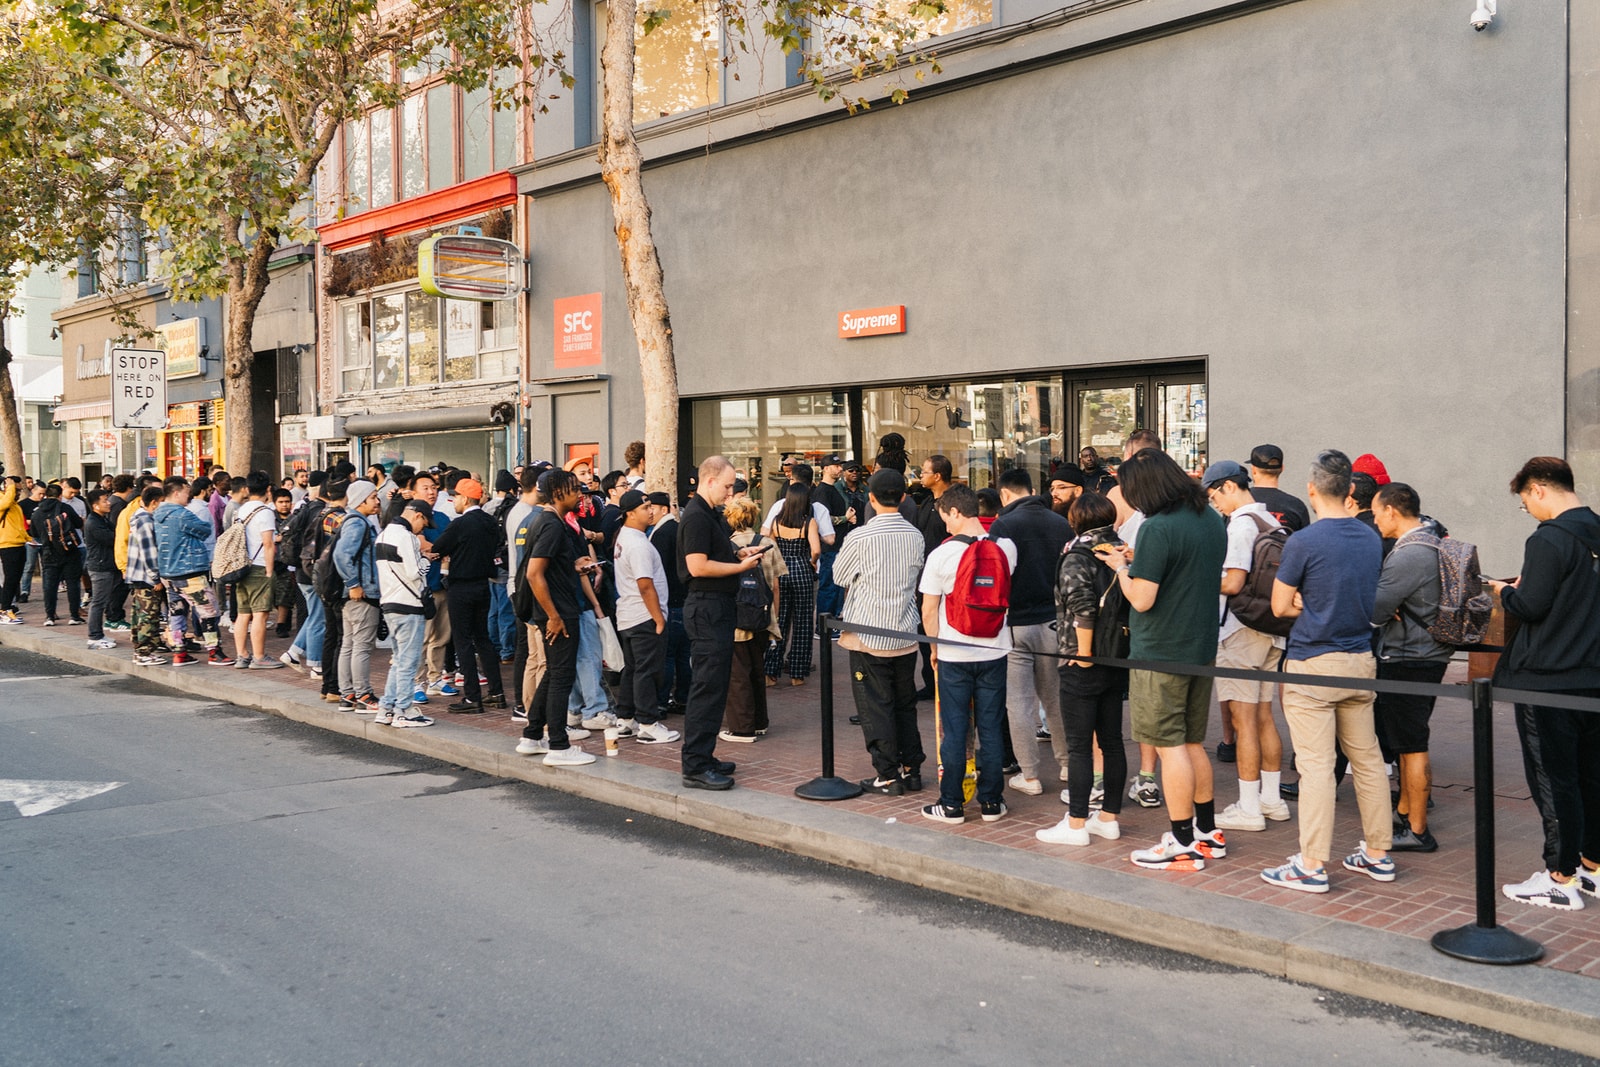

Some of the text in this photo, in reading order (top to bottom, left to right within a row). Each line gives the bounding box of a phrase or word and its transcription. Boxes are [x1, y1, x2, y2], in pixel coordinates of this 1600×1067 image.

[563, 310, 593, 334] SFC
[842, 313, 898, 335] Supreme
[119, 355, 159, 370] STOP
[116, 373, 161, 382] HERE ON
[124, 385, 155, 398] RED
